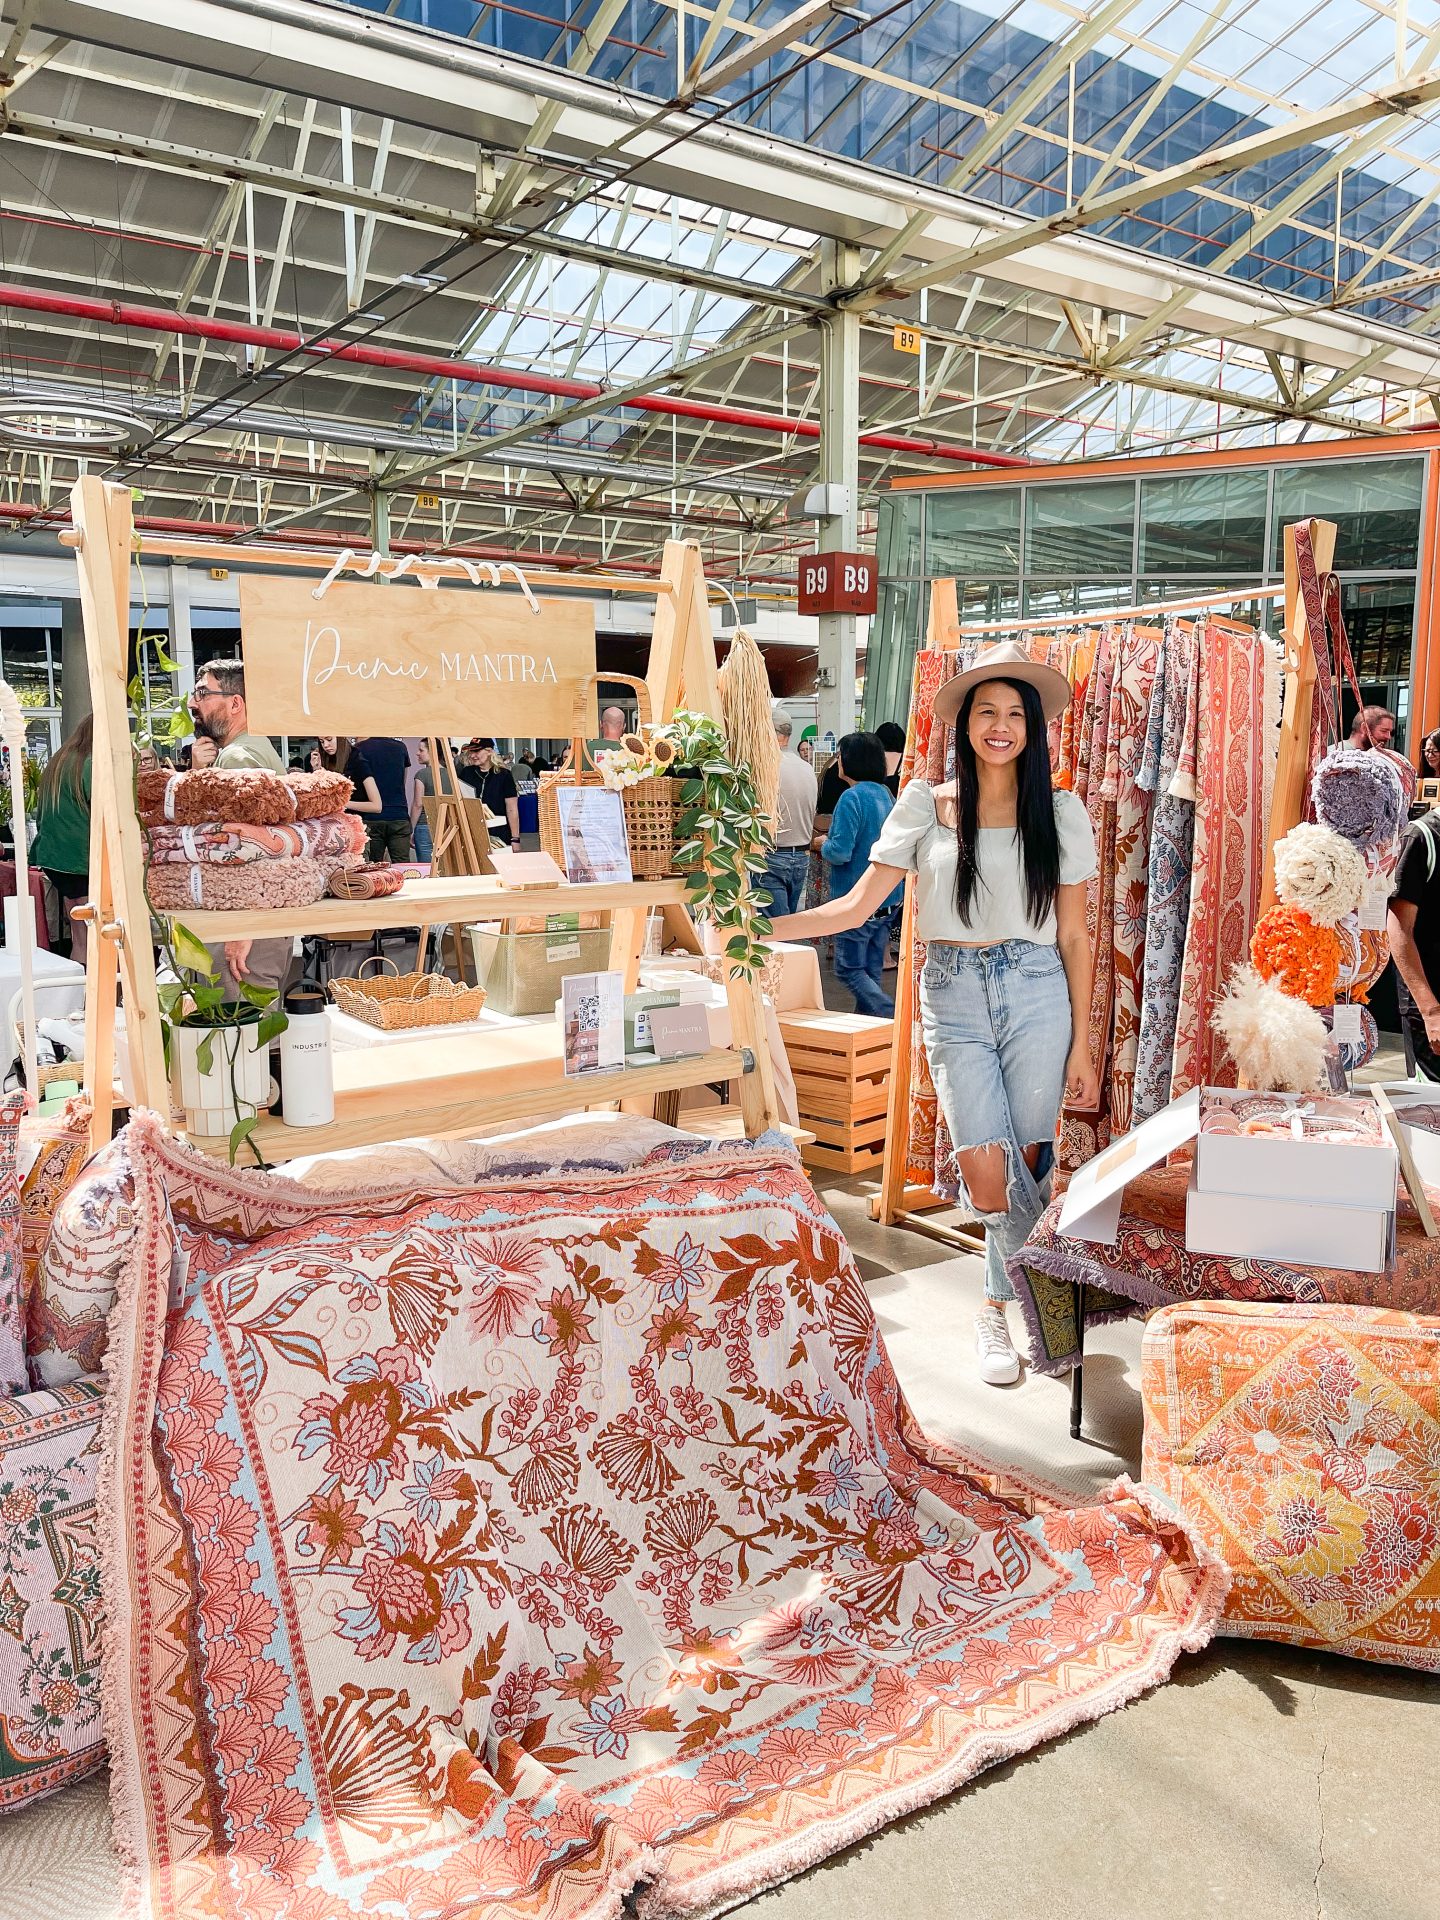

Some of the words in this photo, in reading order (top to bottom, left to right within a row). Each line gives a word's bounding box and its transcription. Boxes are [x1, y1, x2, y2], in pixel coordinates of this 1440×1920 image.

[901, 331, 914, 349] B9
[423, 496, 434, 507] B8
[215, 569, 224, 578] B7
[806, 566, 827, 595] B9
[844, 565, 869, 594] B9
[302, 619, 428, 716] Picnic
[440, 651, 559, 684] MANTRA
